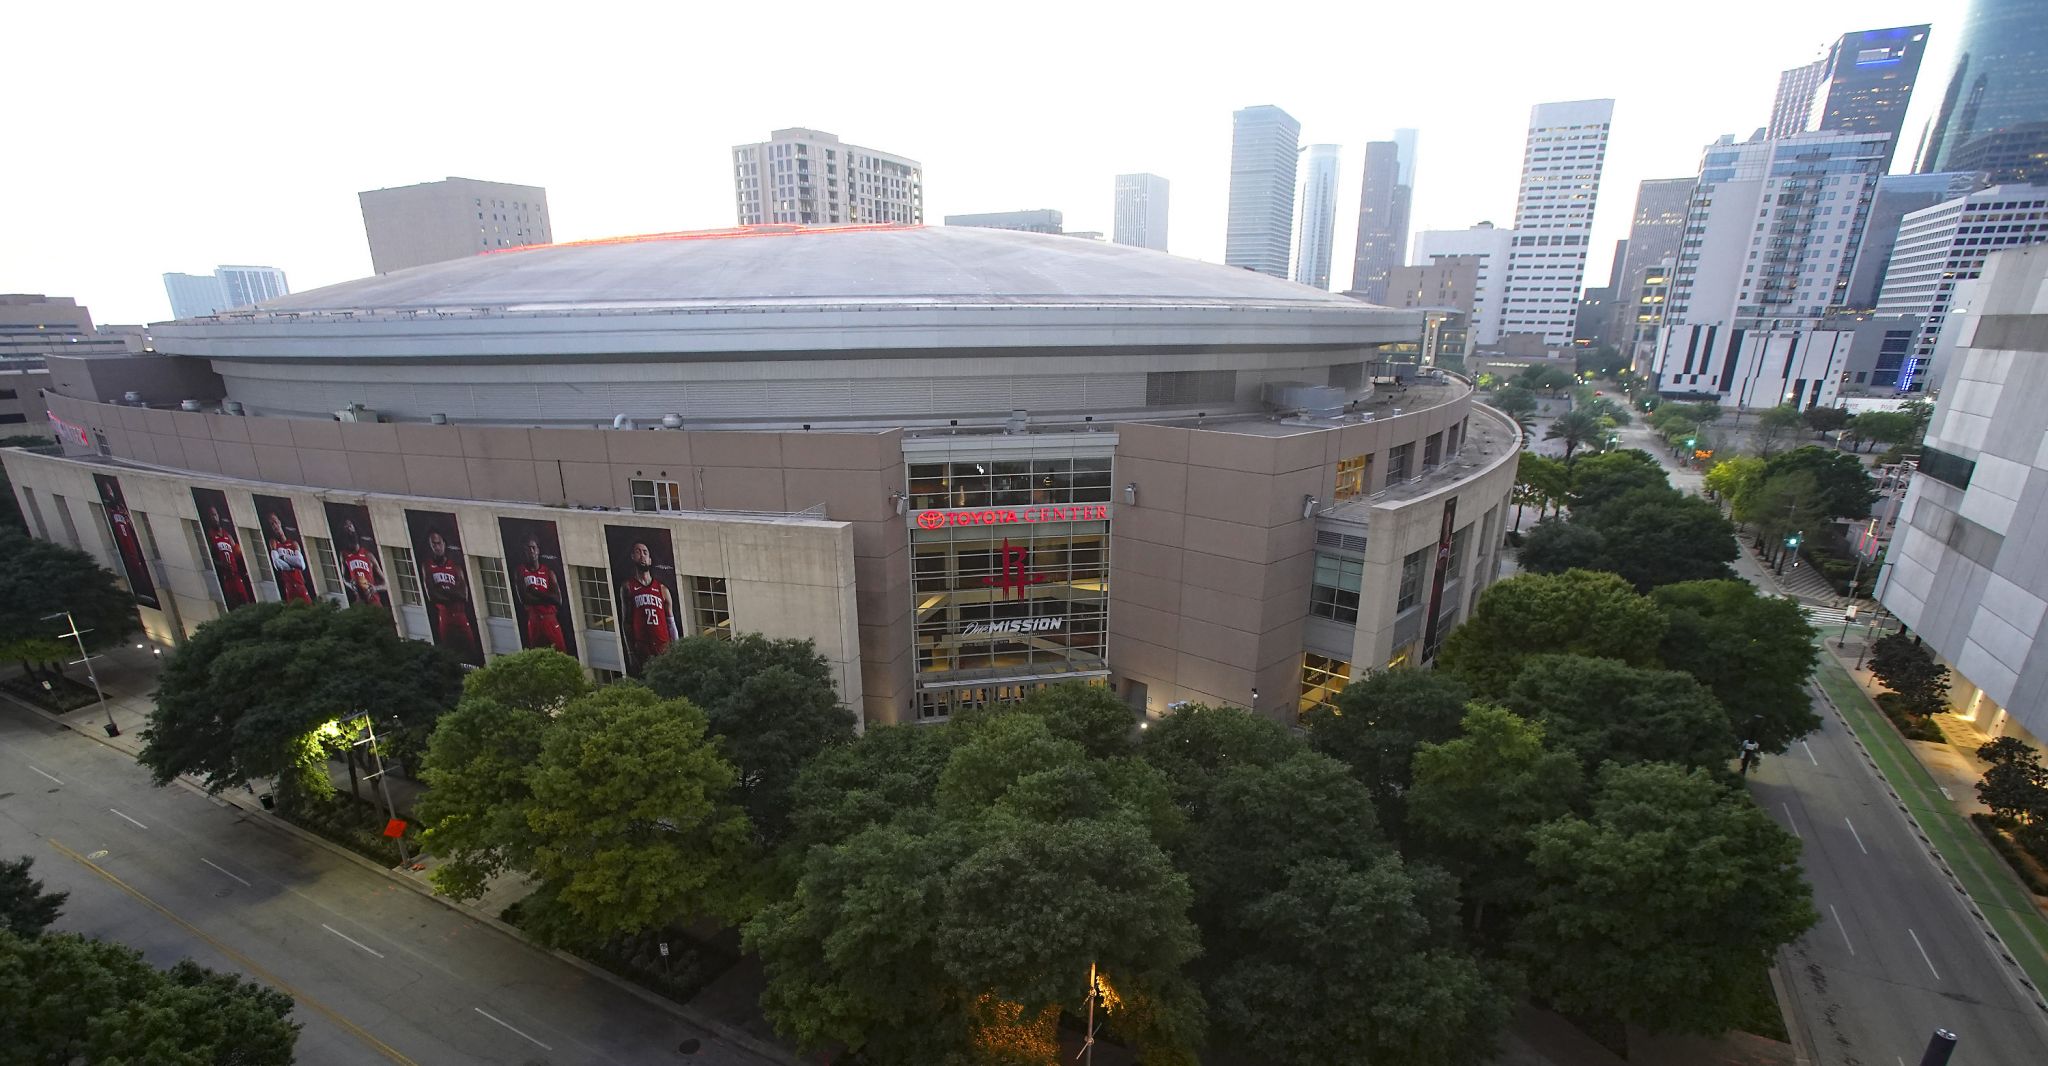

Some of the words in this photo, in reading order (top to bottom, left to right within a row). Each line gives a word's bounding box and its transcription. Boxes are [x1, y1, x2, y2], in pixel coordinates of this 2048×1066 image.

[947, 510, 1018, 525] TOYOTA
[1023, 506, 1108, 523] CENTER
[634, 593, 662, 609] ROCKETS
[645, 608, 659, 625] 25
[988, 617, 1062, 634] MISSION
